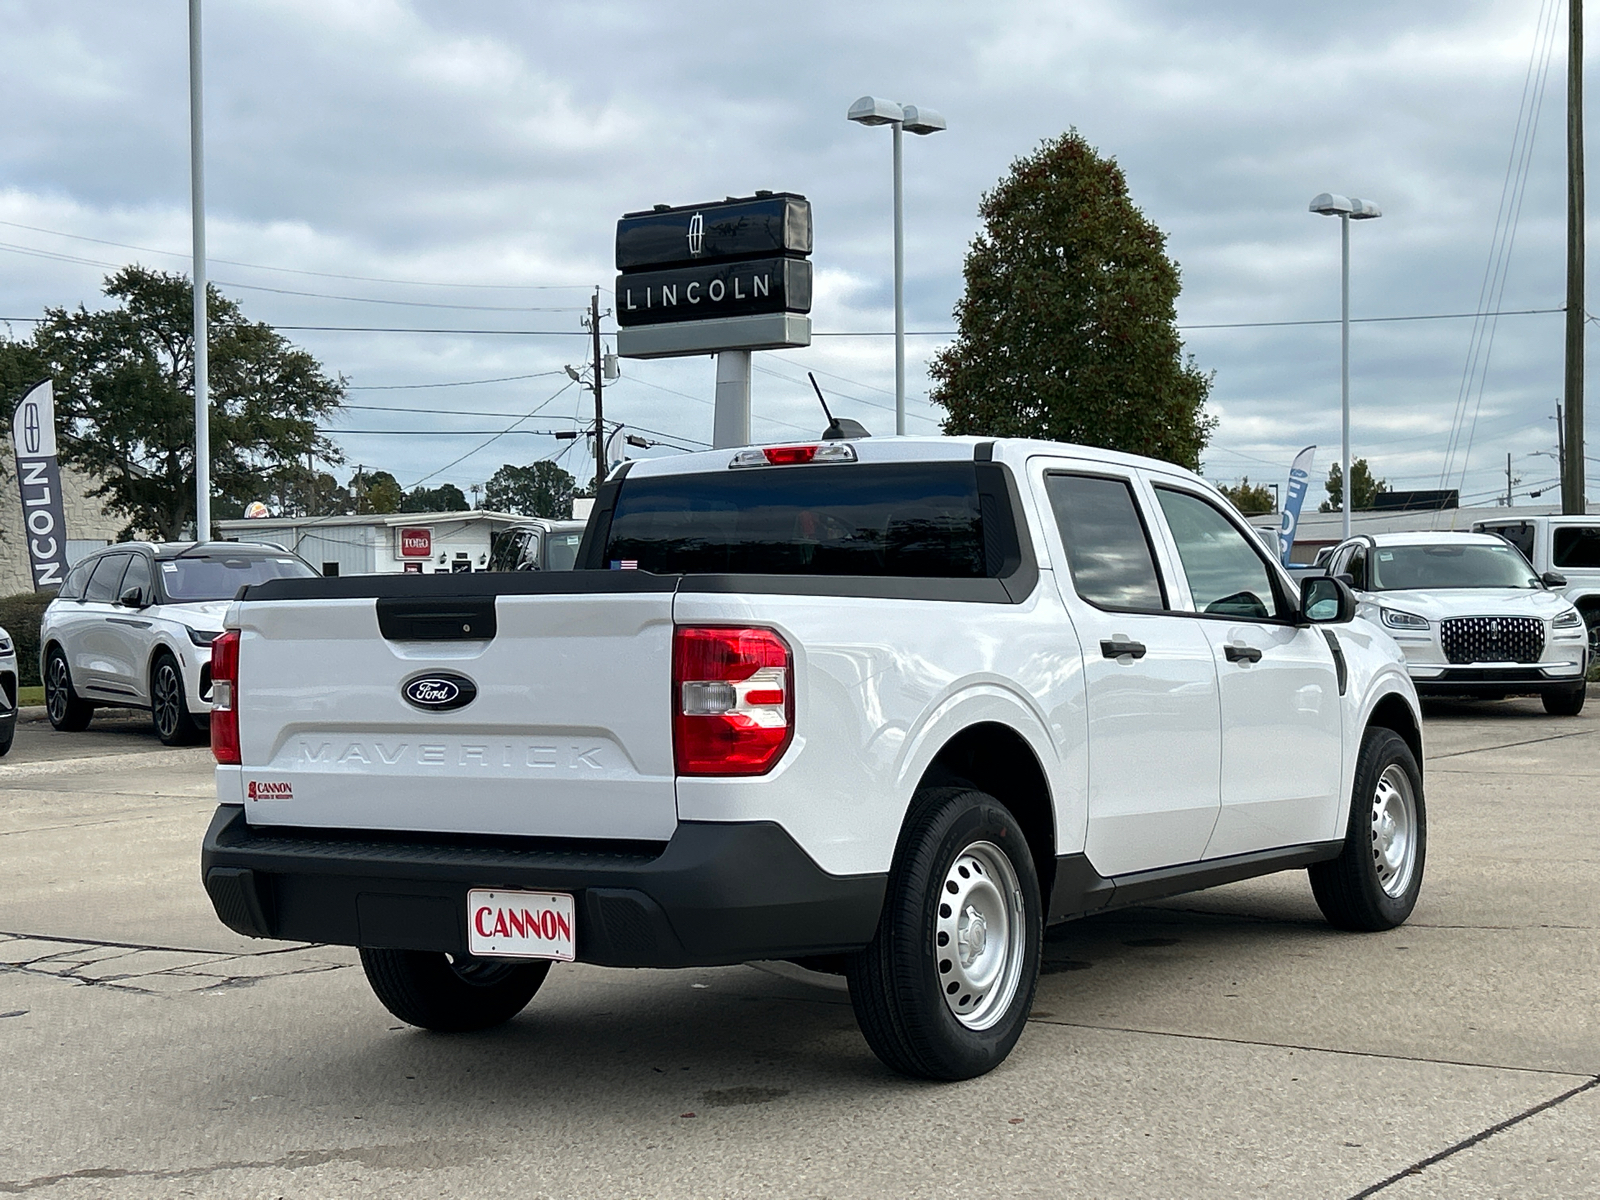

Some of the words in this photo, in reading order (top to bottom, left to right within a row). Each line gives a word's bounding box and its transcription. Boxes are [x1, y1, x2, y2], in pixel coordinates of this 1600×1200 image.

[626, 274, 770, 311] LINCOLN
[403, 537, 429, 549] TORO
[415, 682, 449, 700] Ford
[298, 741, 604, 770] MAVERICK
[257, 782, 293, 794] CANNON
[474, 906, 571, 943] CANNON
